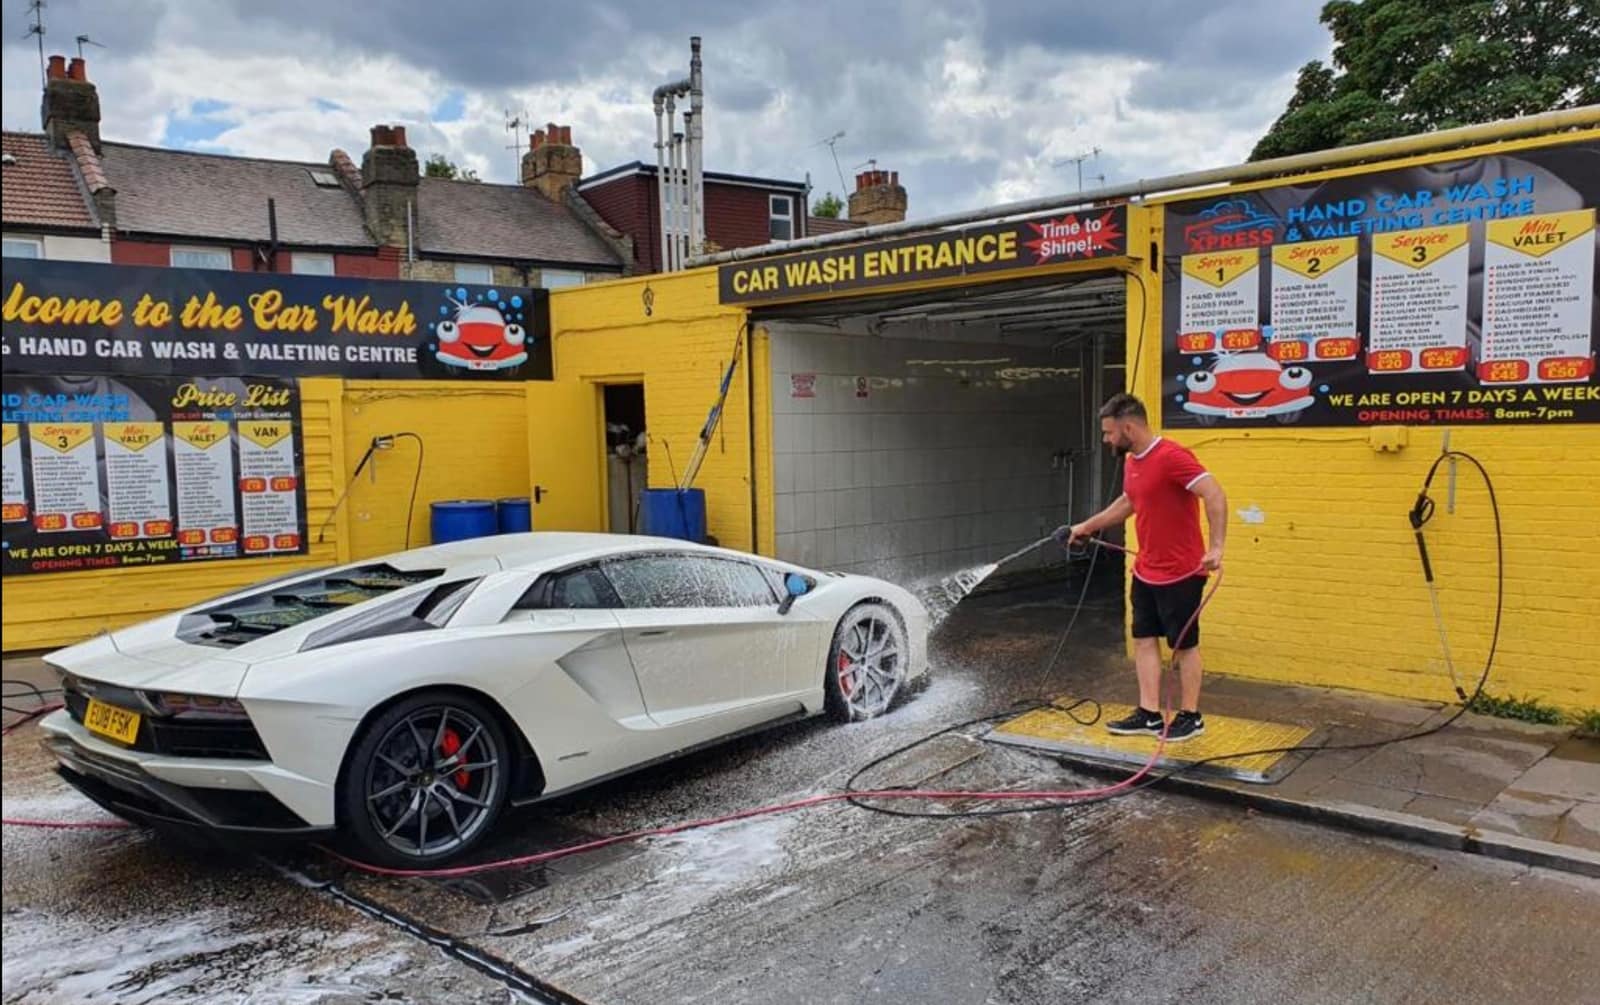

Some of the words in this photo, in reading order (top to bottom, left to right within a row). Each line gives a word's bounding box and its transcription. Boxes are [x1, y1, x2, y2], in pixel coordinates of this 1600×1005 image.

[1288, 198, 1366, 224] HAND
[1376, 190, 1433, 213] CAR
[1444, 174, 1534, 201] WASH
[1040, 220, 1080, 237] Time
[1084, 218, 1102, 233] to
[1286, 228, 1302, 242] &
[1309, 213, 1424, 238] VALETING
[1432, 199, 1535, 225] CENTRE
[1520, 218, 1559, 235] Mini
[1392, 232, 1448, 248] Service
[1512, 231, 1566, 248] VALET
[1289, 246, 1340, 260] Service
[1412, 246, 1426, 262] 3
[733, 269, 779, 294] CAR
[785, 255, 856, 288] WASH
[864, 231, 1017, 278] ENTRANCE
[1196, 256, 1244, 270] Service
[1307, 258, 1320, 273] 2
[1216, 267, 1224, 282] 1
[132, 294, 172, 328] to
[180, 291, 244, 329] the
[248, 288, 318, 332] Car
[322, 294, 417, 335] Wash
[18, 337, 87, 356] HAND
[94, 339, 143, 358] CAR
[151, 341, 216, 360] WASH
[223, 342, 240, 360] &
[244, 342, 340, 362] VALETING
[345, 345, 418, 363] CENTRE
[1490, 368, 1519, 380] £45
[1547, 368, 1577, 378] £50
[28, 394, 67, 407] CAR
[172, 383, 237, 408] Price
[241, 384, 291, 407] List
[1328, 394, 1354, 406] WE
[1357, 393, 1391, 406] ARE
[1396, 390, 1446, 405] OPEN
[1451, 390, 1462, 404] 7
[1468, 389, 1516, 403] DAYS
[1522, 388, 1538, 401] A
[1542, 386, 1600, 400] WEEK
[1358, 408, 1430, 421] OPENING
[1435, 408, 1489, 420] TIMES:
[1494, 407, 1574, 420] 8am-7pm
[120, 435, 150, 444] VALET
[252, 426, 279, 437] VAN
[58, 436, 68, 448] 3
[8, 548, 28, 560] WE
[31, 547, 55, 558] ARE
[58, 545, 92, 556] OPEN
[94, 544, 102, 554] 7
[104, 542, 134, 553] DAYS
[136, 542, 146, 551] A
[147, 540, 178, 550] WEEK
